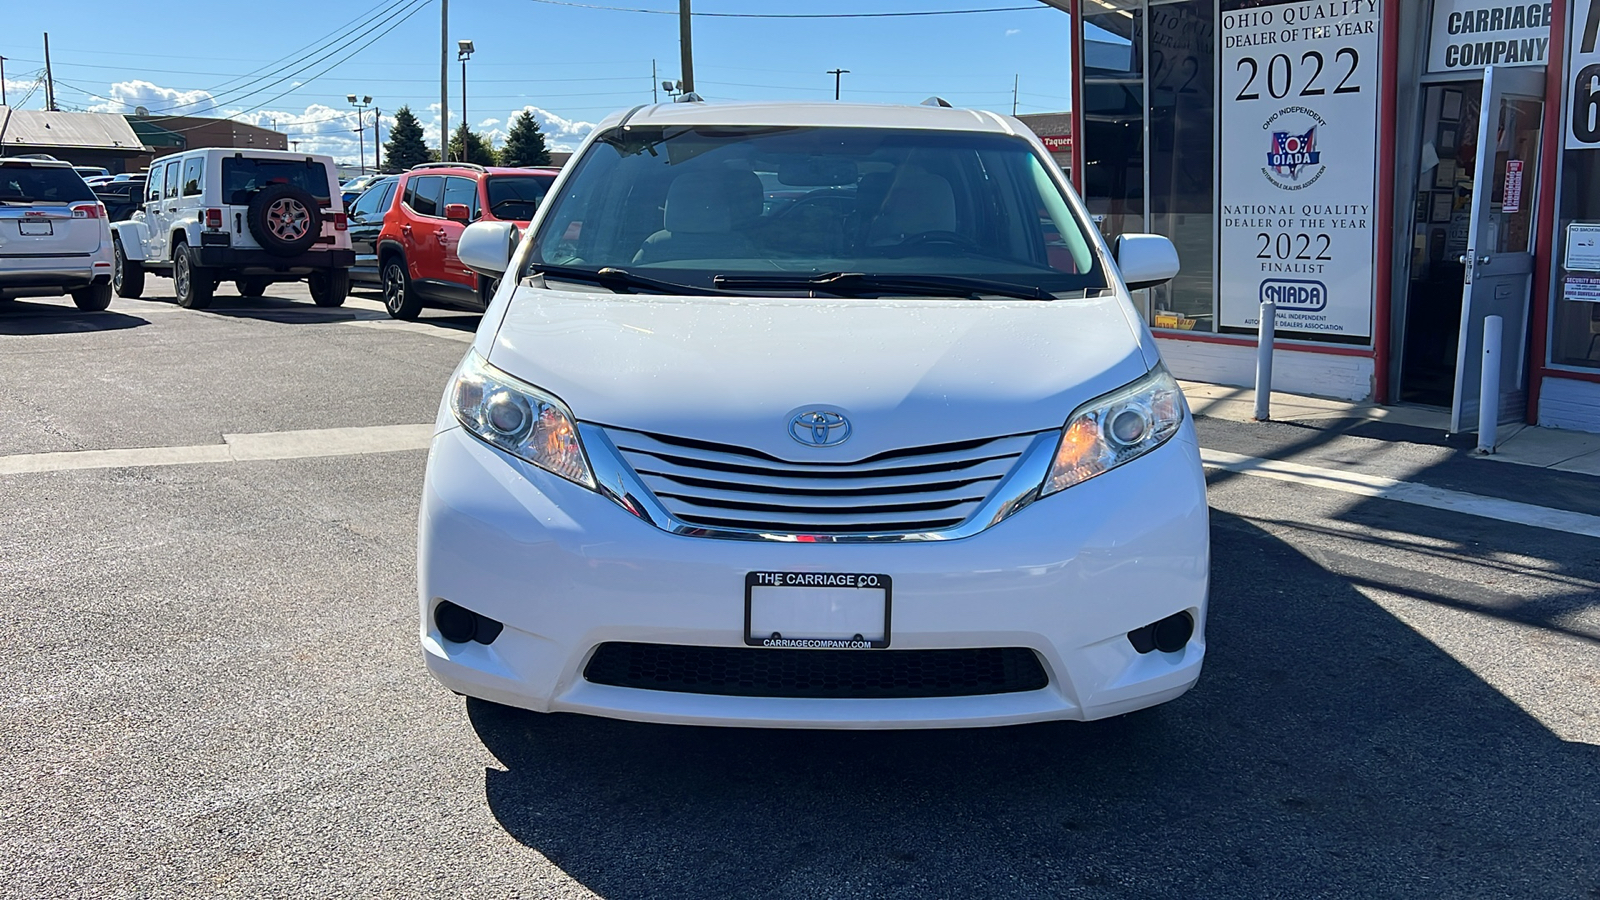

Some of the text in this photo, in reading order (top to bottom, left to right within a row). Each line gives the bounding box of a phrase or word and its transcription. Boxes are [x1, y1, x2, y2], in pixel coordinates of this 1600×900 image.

[1223, 0, 1376, 29] OHIO QUALITY
[1447, 2, 1552, 35] CARRIAGE
[1225, 20, 1374, 48] DEALER OF THE YEAR
[1445, 37, 1549, 67] COMPANY
[1235, 47, 1361, 101] 2022
[1262, 106, 1327, 130] OHIO INDEPENDENT
[1273, 153, 1311, 165] OIADA
[1223, 205, 1369, 216] NATIONAL QUALITY
[1225, 219, 1366, 229] DEALER OF THE YEAR
[1256, 232, 1332, 261] 2022
[1261, 262, 1325, 273] FINALIST
[1265, 286, 1320, 304] NIADA
[1288, 313, 1327, 321] INDEPENDENT
[1304, 320, 1343, 331] ASSOCIATION
[756, 572, 881, 586] THE CARRIAGE CO.
[763, 639, 872, 649] CARRIAGECOMPANY.COM
